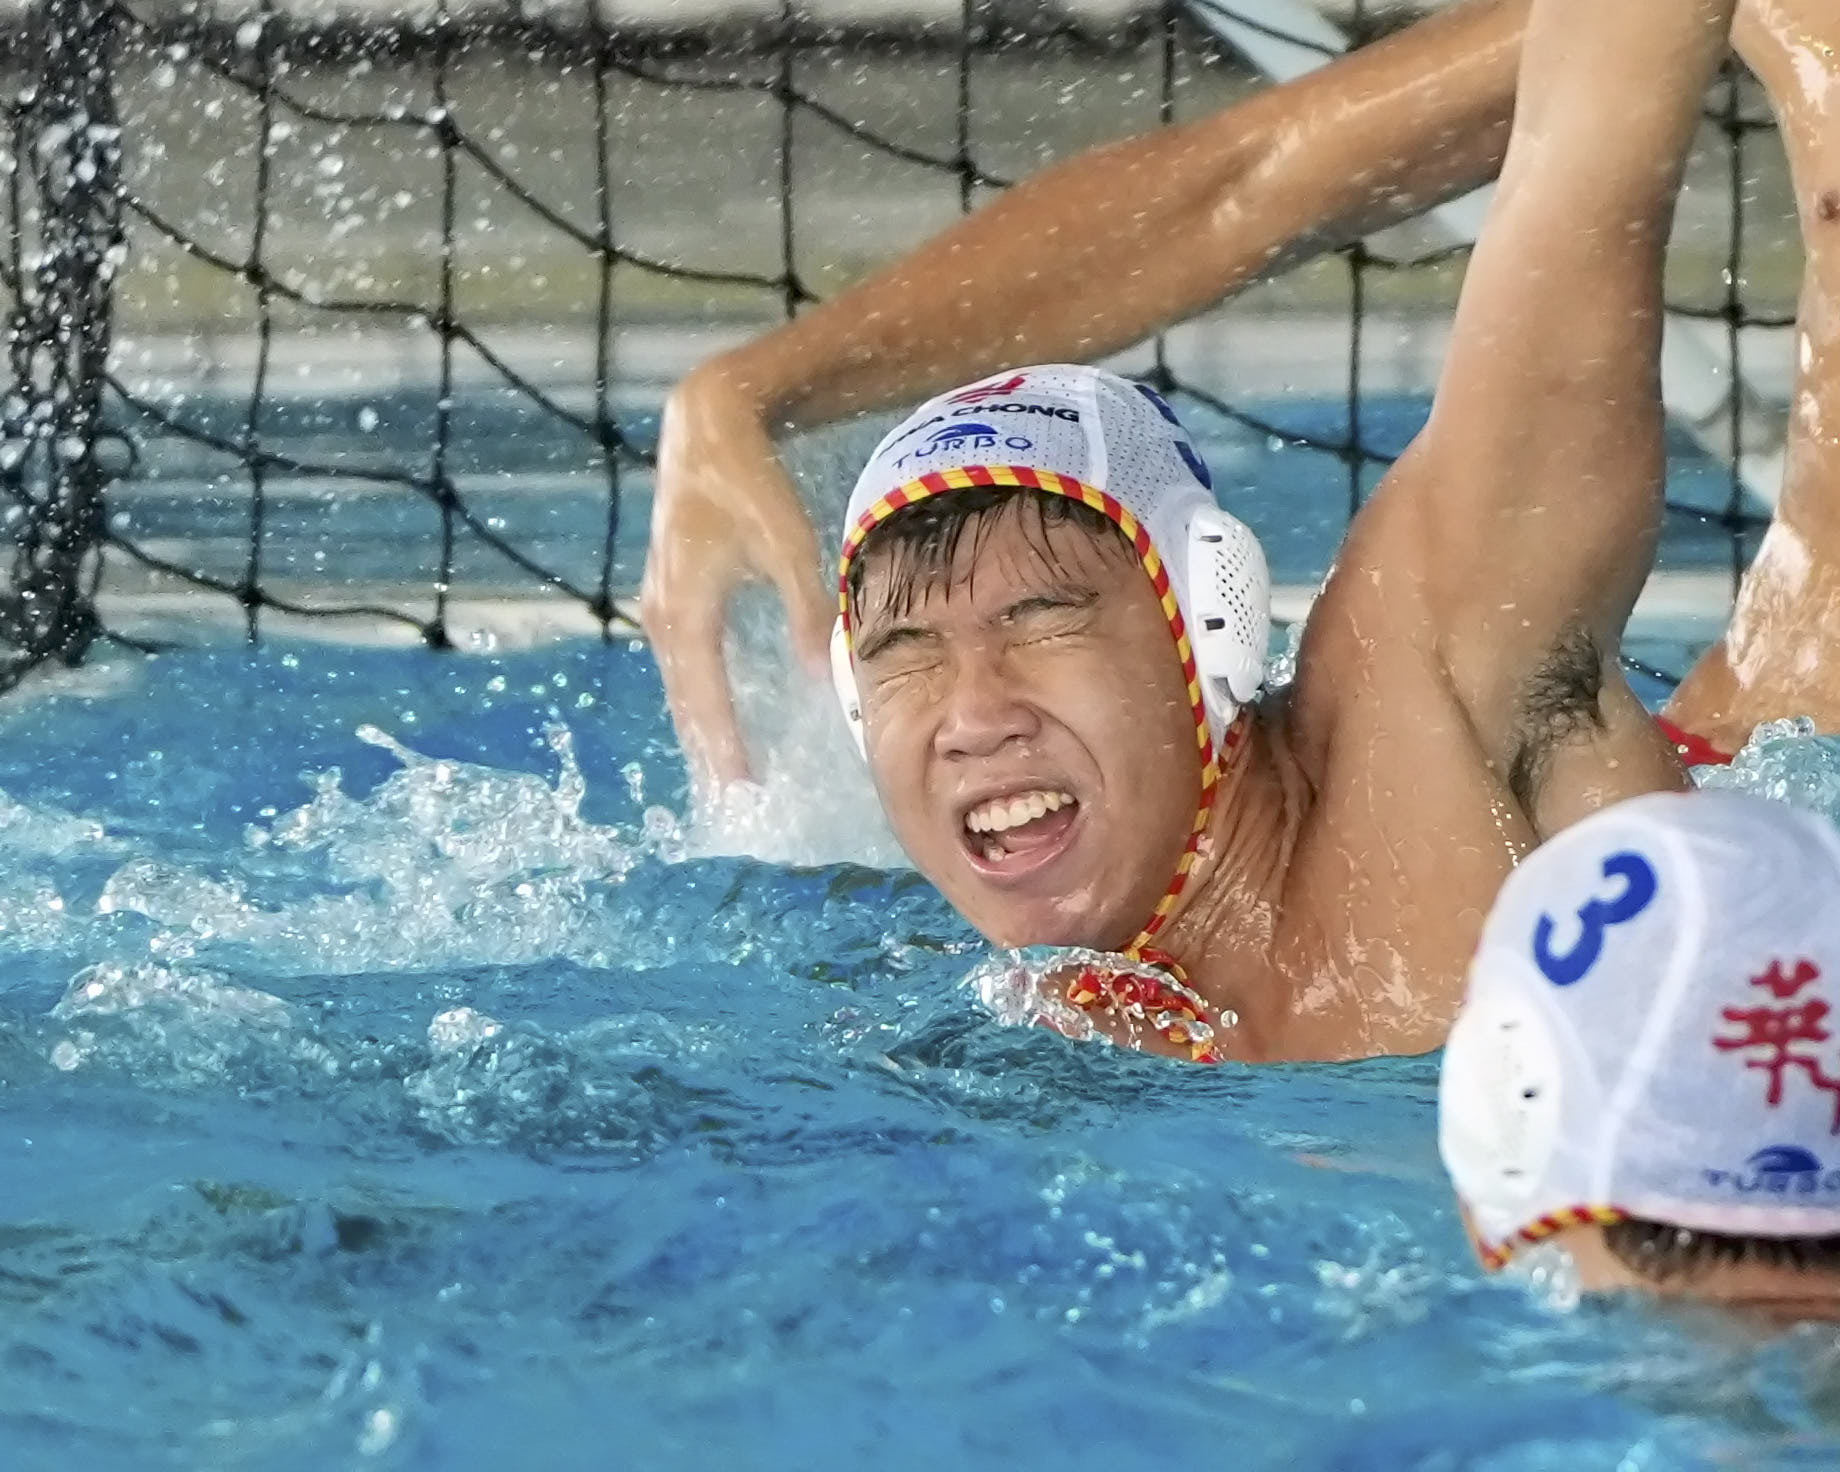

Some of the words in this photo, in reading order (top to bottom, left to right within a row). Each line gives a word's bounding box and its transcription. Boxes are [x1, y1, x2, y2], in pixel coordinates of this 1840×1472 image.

[951, 402, 1081, 423] CHONG
[891, 435, 1034, 469] TURBO
[1532, 850, 1658, 987] 3
